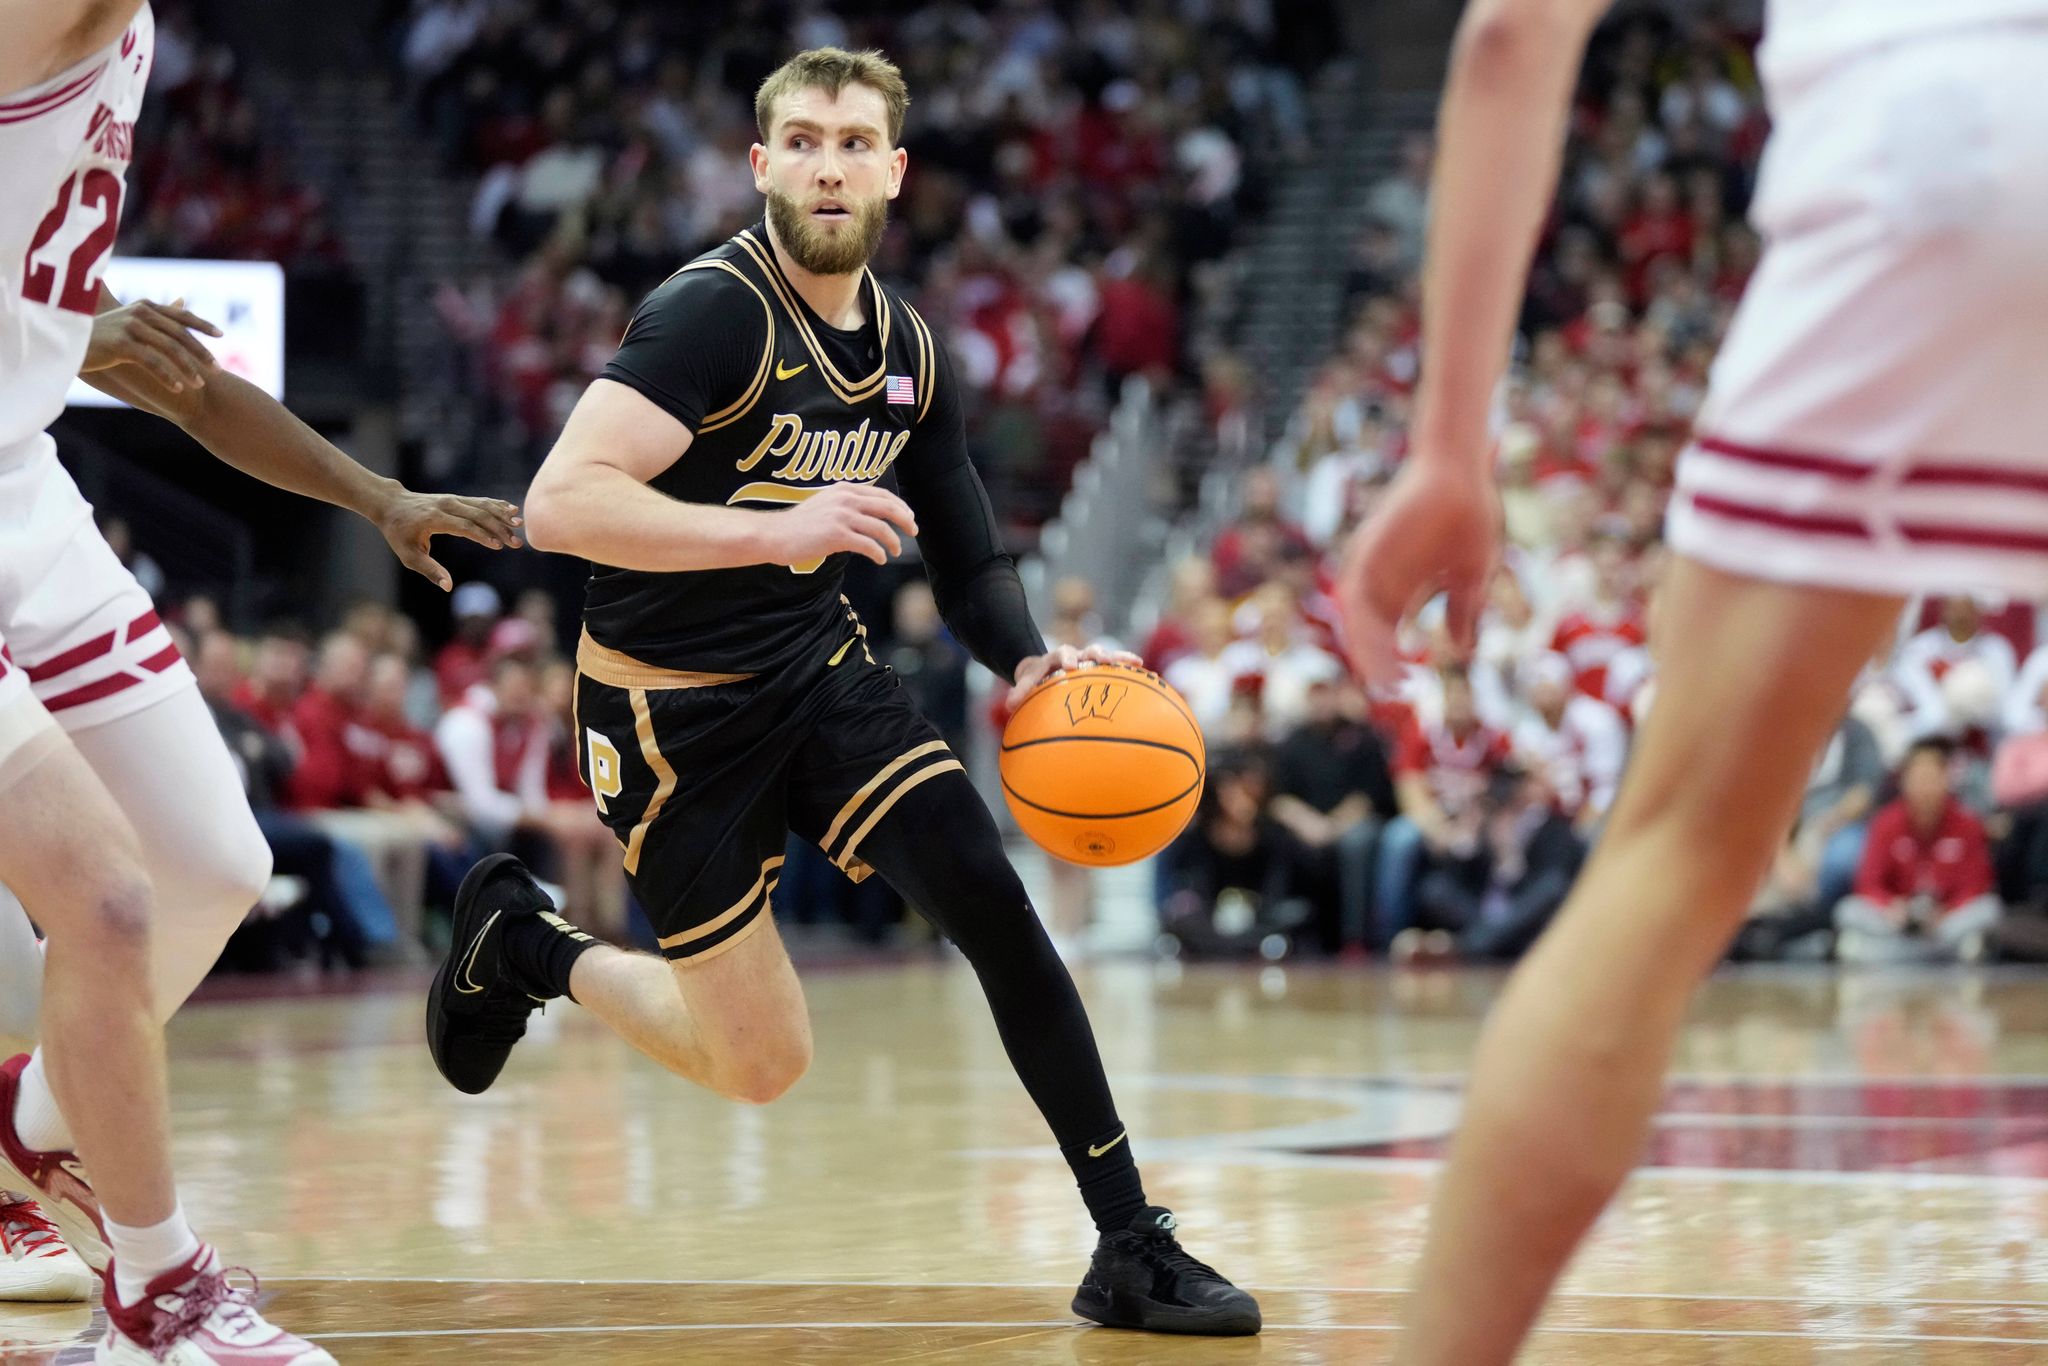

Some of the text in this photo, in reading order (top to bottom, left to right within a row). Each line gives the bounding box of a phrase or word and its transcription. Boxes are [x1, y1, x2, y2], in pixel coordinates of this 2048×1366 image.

[21, 168, 121, 316] 22
[736, 413, 911, 481] Purdue
[1065, 683, 1128, 726] W
[586, 726, 623, 815] P
